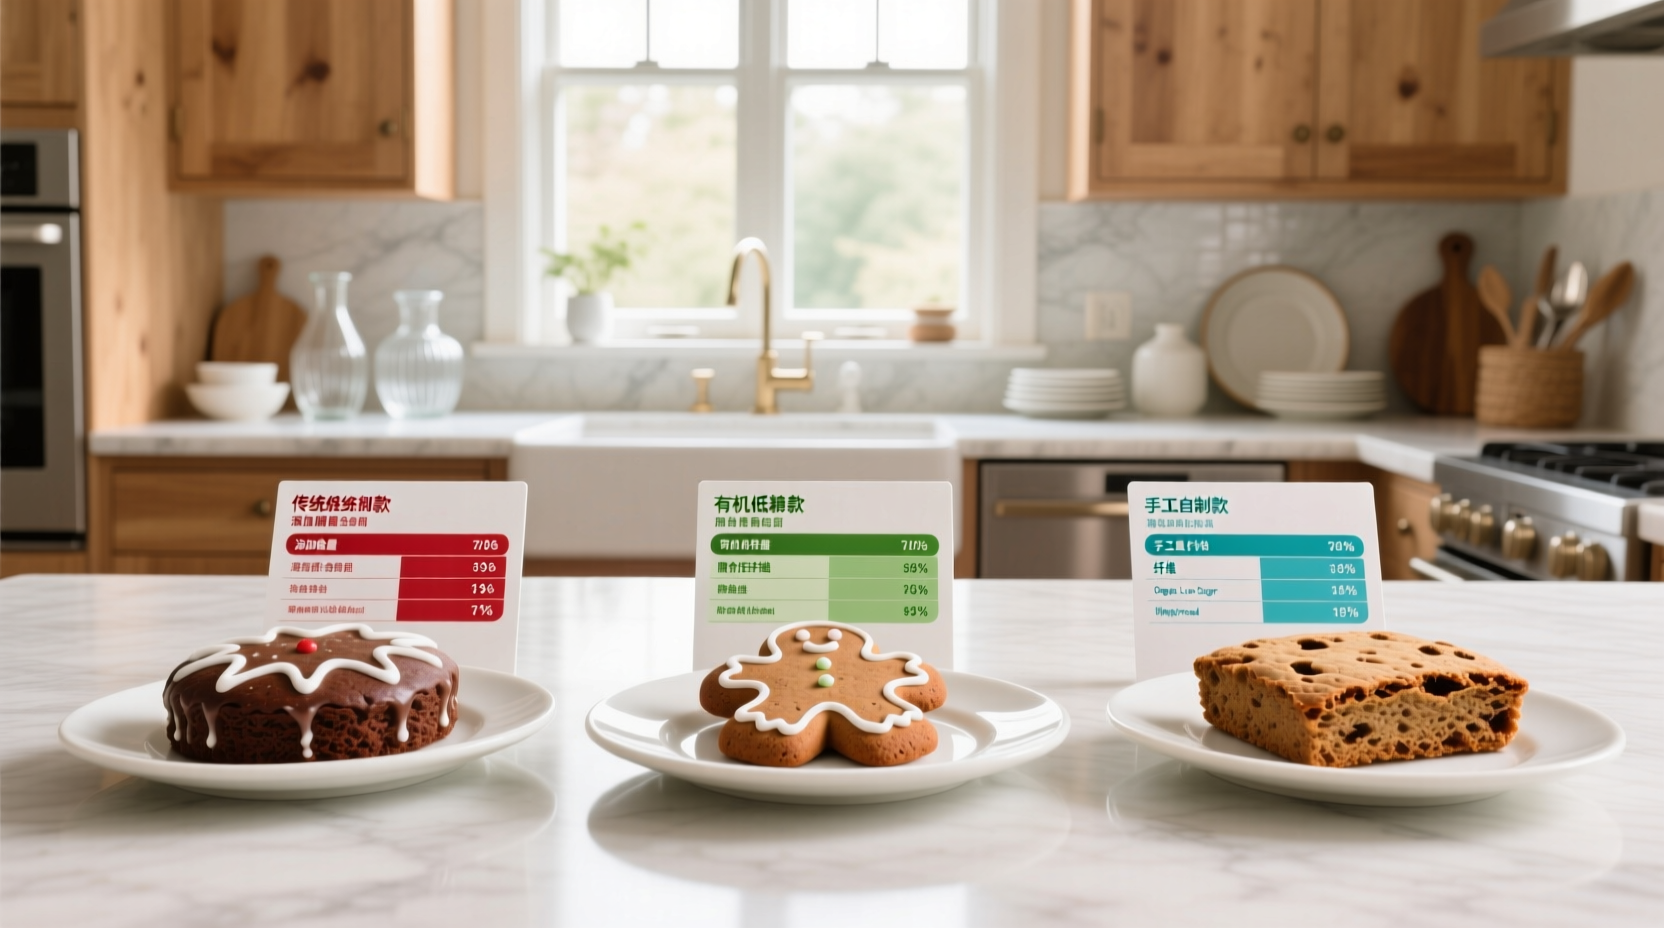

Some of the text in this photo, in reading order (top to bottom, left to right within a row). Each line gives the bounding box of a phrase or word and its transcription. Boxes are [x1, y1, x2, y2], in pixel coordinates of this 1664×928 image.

[1144, 495, 1229, 515] 手工自制款
